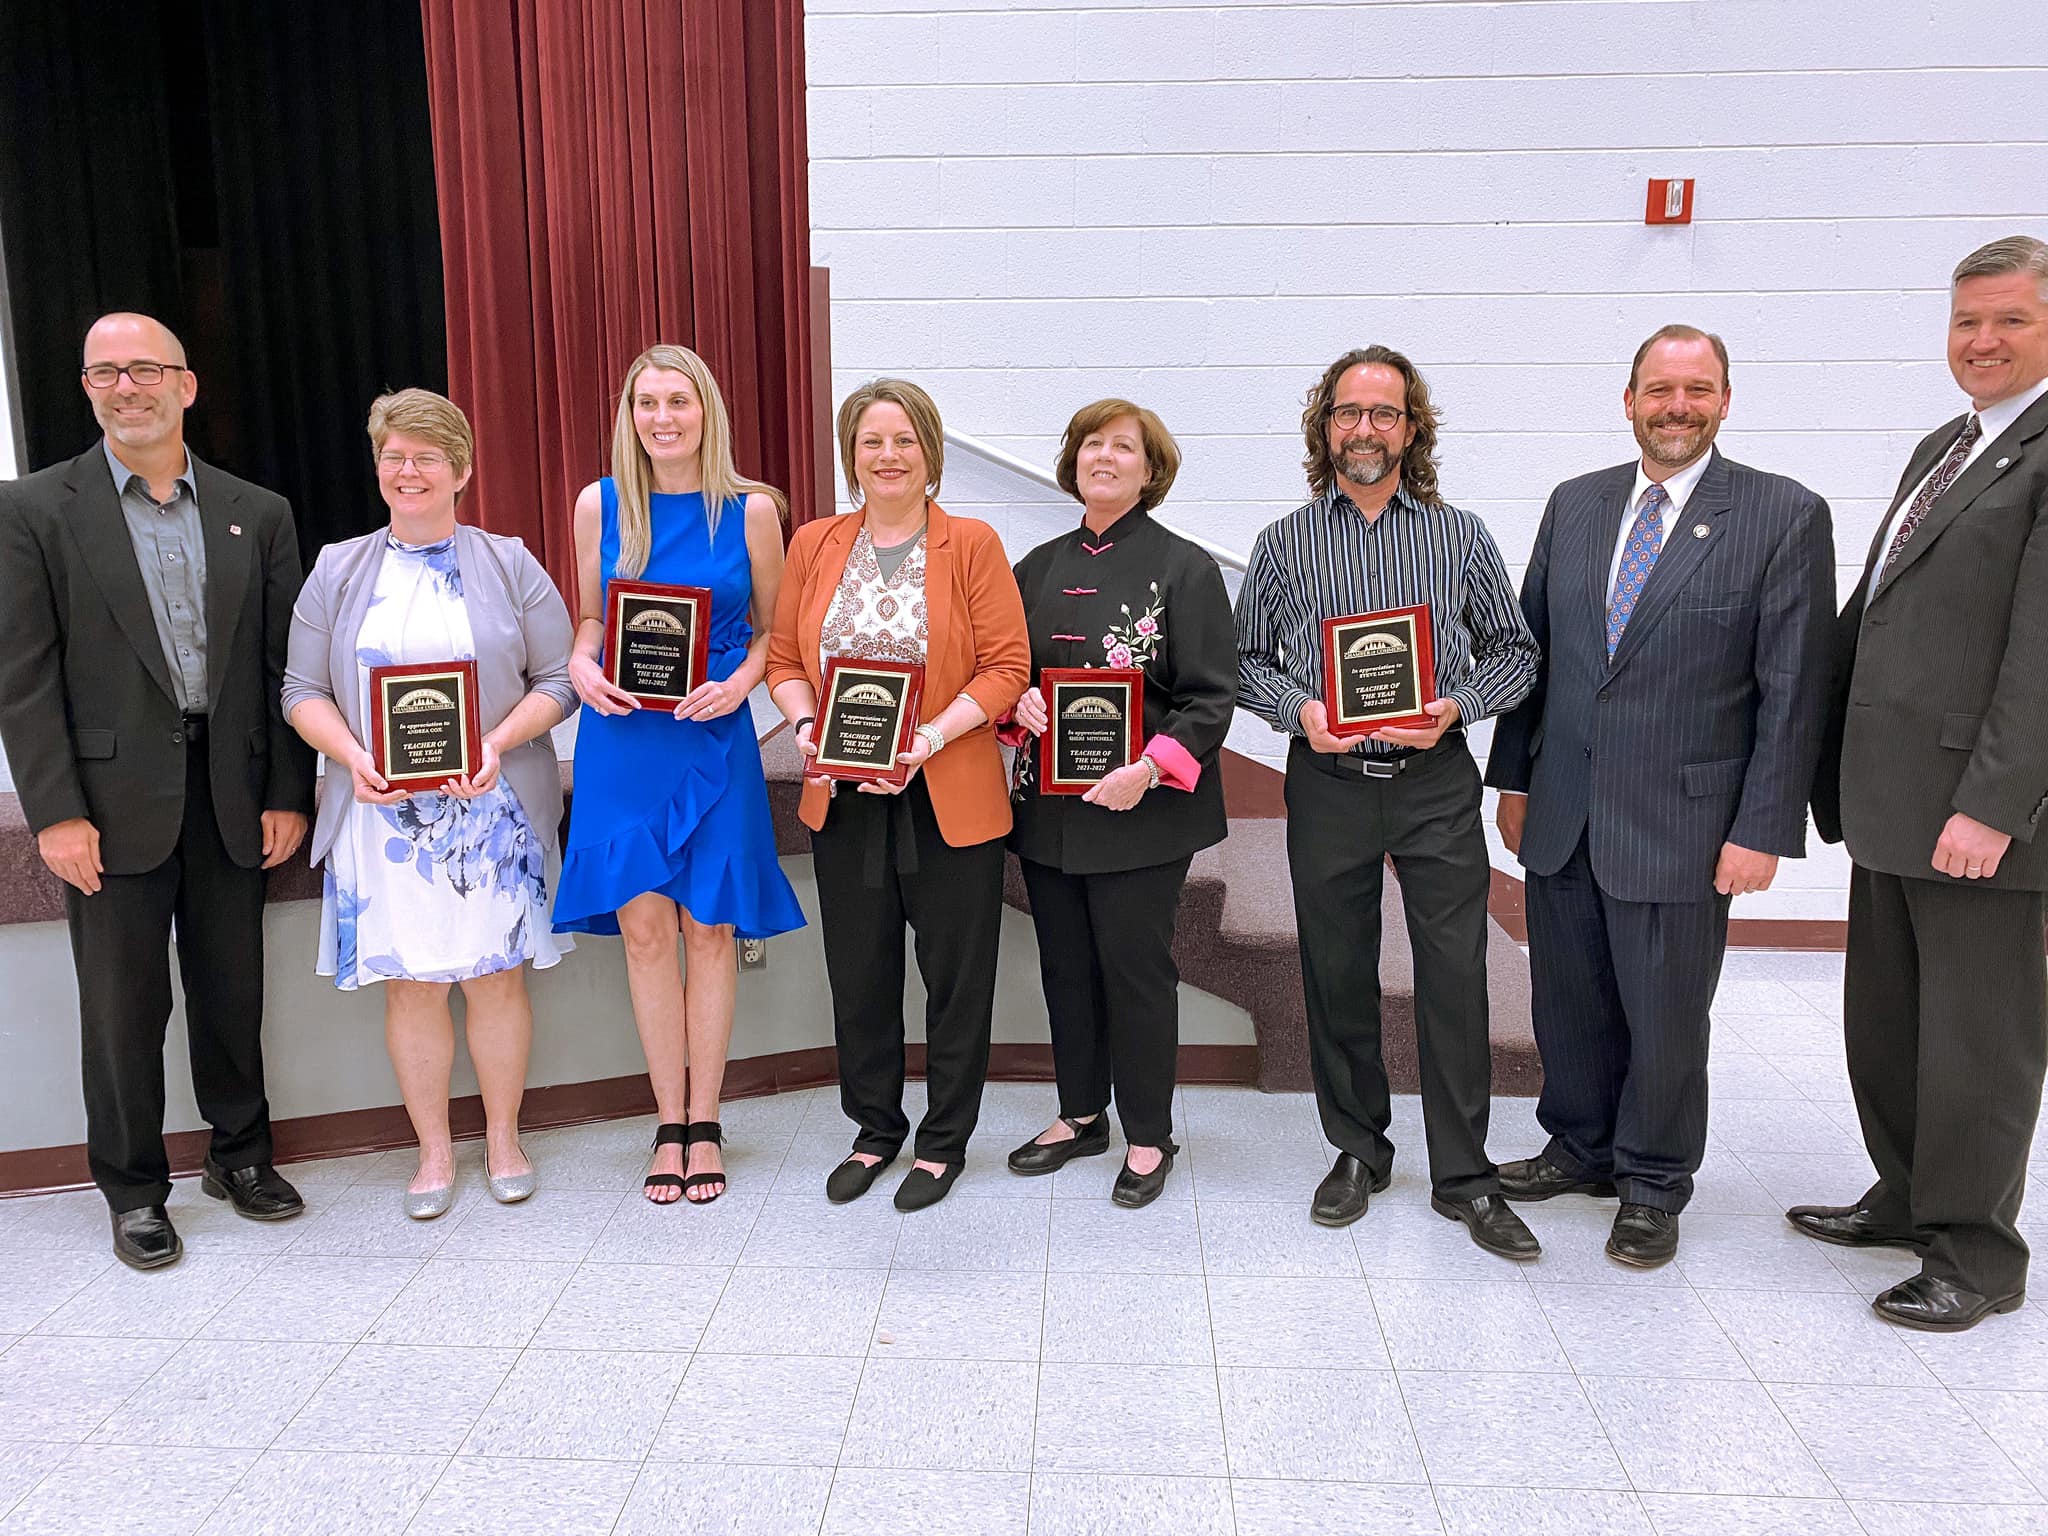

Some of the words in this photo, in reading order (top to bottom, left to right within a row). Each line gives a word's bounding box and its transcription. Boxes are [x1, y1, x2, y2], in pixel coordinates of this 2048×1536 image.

[638, 643, 672, 651] appreciation
[633, 662, 664, 670] TEACHER
[1359, 664, 1395, 673] appreciation
[652, 671, 670, 679] YEAR
[638, 678, 667, 686] 2021-2022
[1355, 684, 1389, 693] TEACHER
[1377, 690, 1396, 698] YEAR
[1363, 698, 1395, 707] 2021-2022
[847, 714, 881, 722] appreciation
[407, 721, 443, 730] appreciation
[839, 732, 870, 740] TEACHER
[403, 741, 437, 750] TEACHER
[842, 739, 856, 747] THE
[857, 741, 875, 749] YEAR
[842, 747, 872, 755] 2021-2022
[411, 756, 442, 764] 2021-2022
